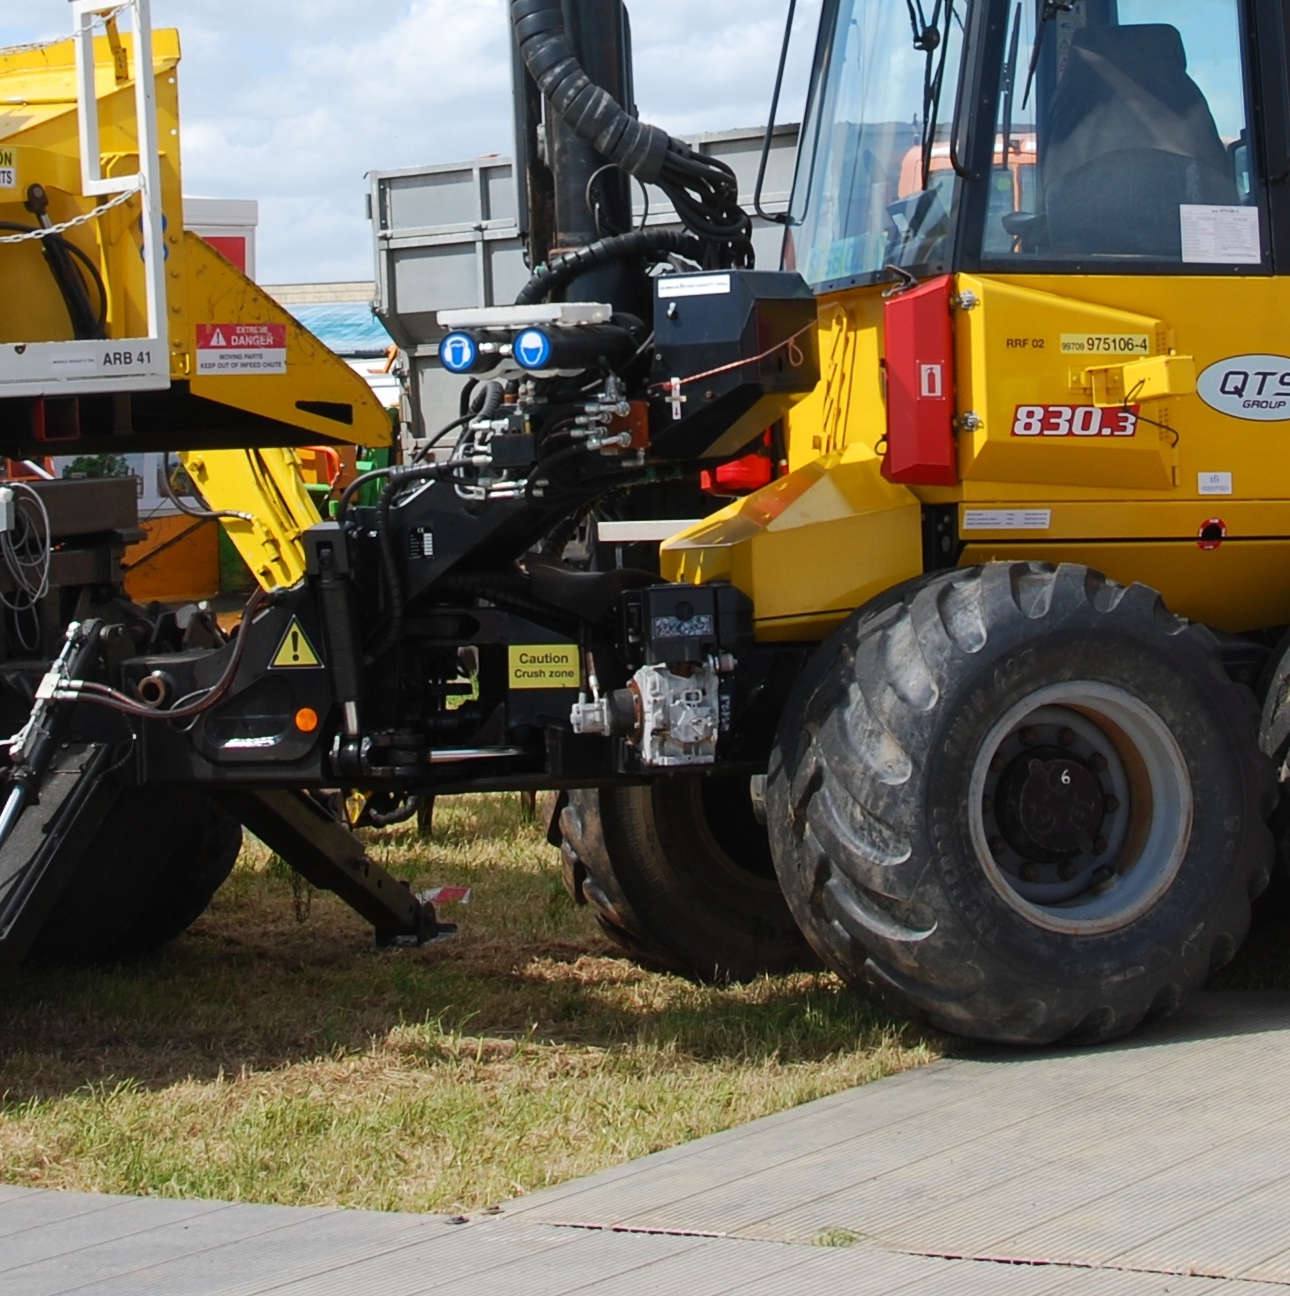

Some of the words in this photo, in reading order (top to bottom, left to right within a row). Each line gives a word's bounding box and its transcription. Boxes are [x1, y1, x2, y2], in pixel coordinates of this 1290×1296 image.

[231, 335, 274, 346] DANGER
[1006, 339, 1028, 348] RRF
[1032, 339, 1045, 348] 02
[1087, 337, 1148, 351] 975106-4
[103, 351, 132, 366] ARB
[137, 351, 151, 364] 41
[1242, 400, 1287, 409] GROUP
[1014, 406, 1136, 435] 830.3
[519, 653, 569, 664] Caution
[514, 669, 546, 679] Crush
[549, 670, 575, 678] zone
[1061, 768, 1070, 784] 6
